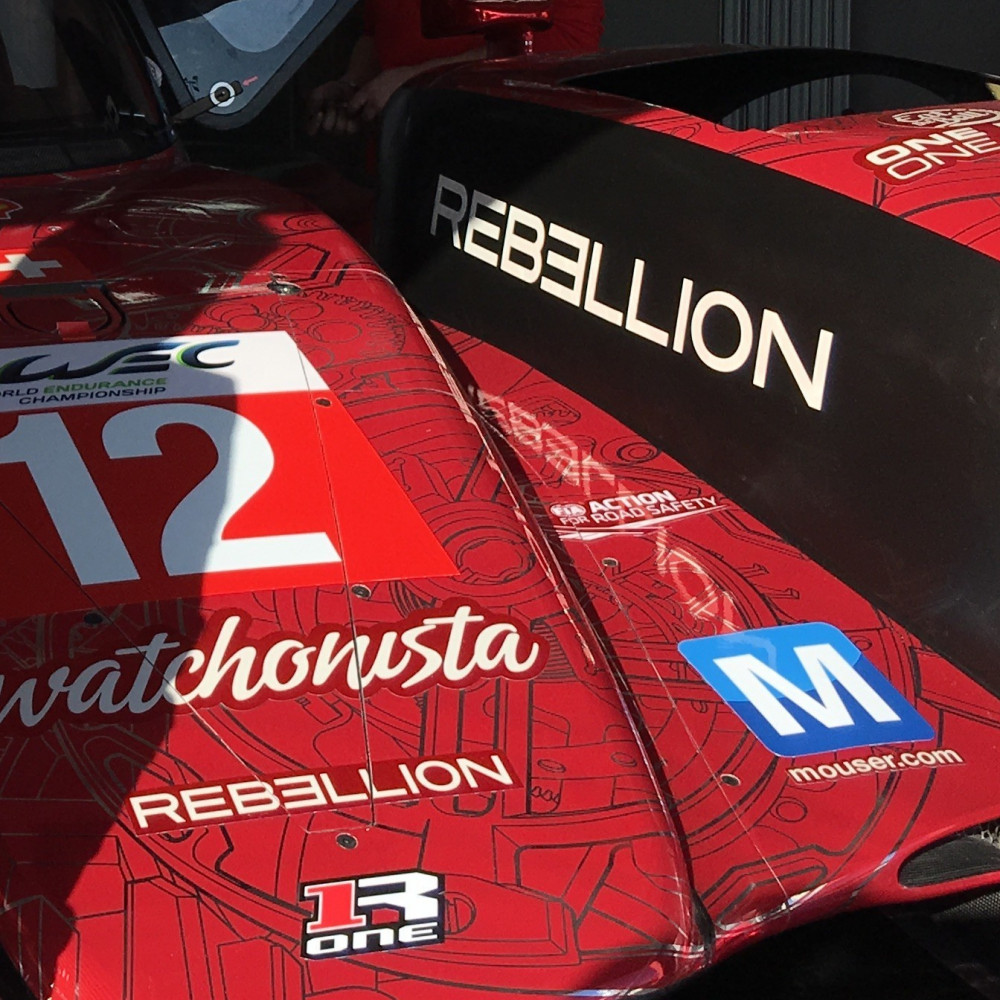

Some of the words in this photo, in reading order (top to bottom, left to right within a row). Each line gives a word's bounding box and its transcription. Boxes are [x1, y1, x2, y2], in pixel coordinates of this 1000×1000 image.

[865, 126, 988, 166] ONE
[429, 174, 835, 412] REBELLION
[18, 386, 167, 406] CHAMPIONSHIP
[43, 377, 168, 395] ENDURANCE
[589, 489, 677, 514] ACTION
[590, 506, 646, 525] ROAD
[646, 495, 718, 516] SAFETY
[712, 643, 901, 737] M
[788, 749, 964, 783] mouser.com
[128, 754, 514, 829] REBELLION
